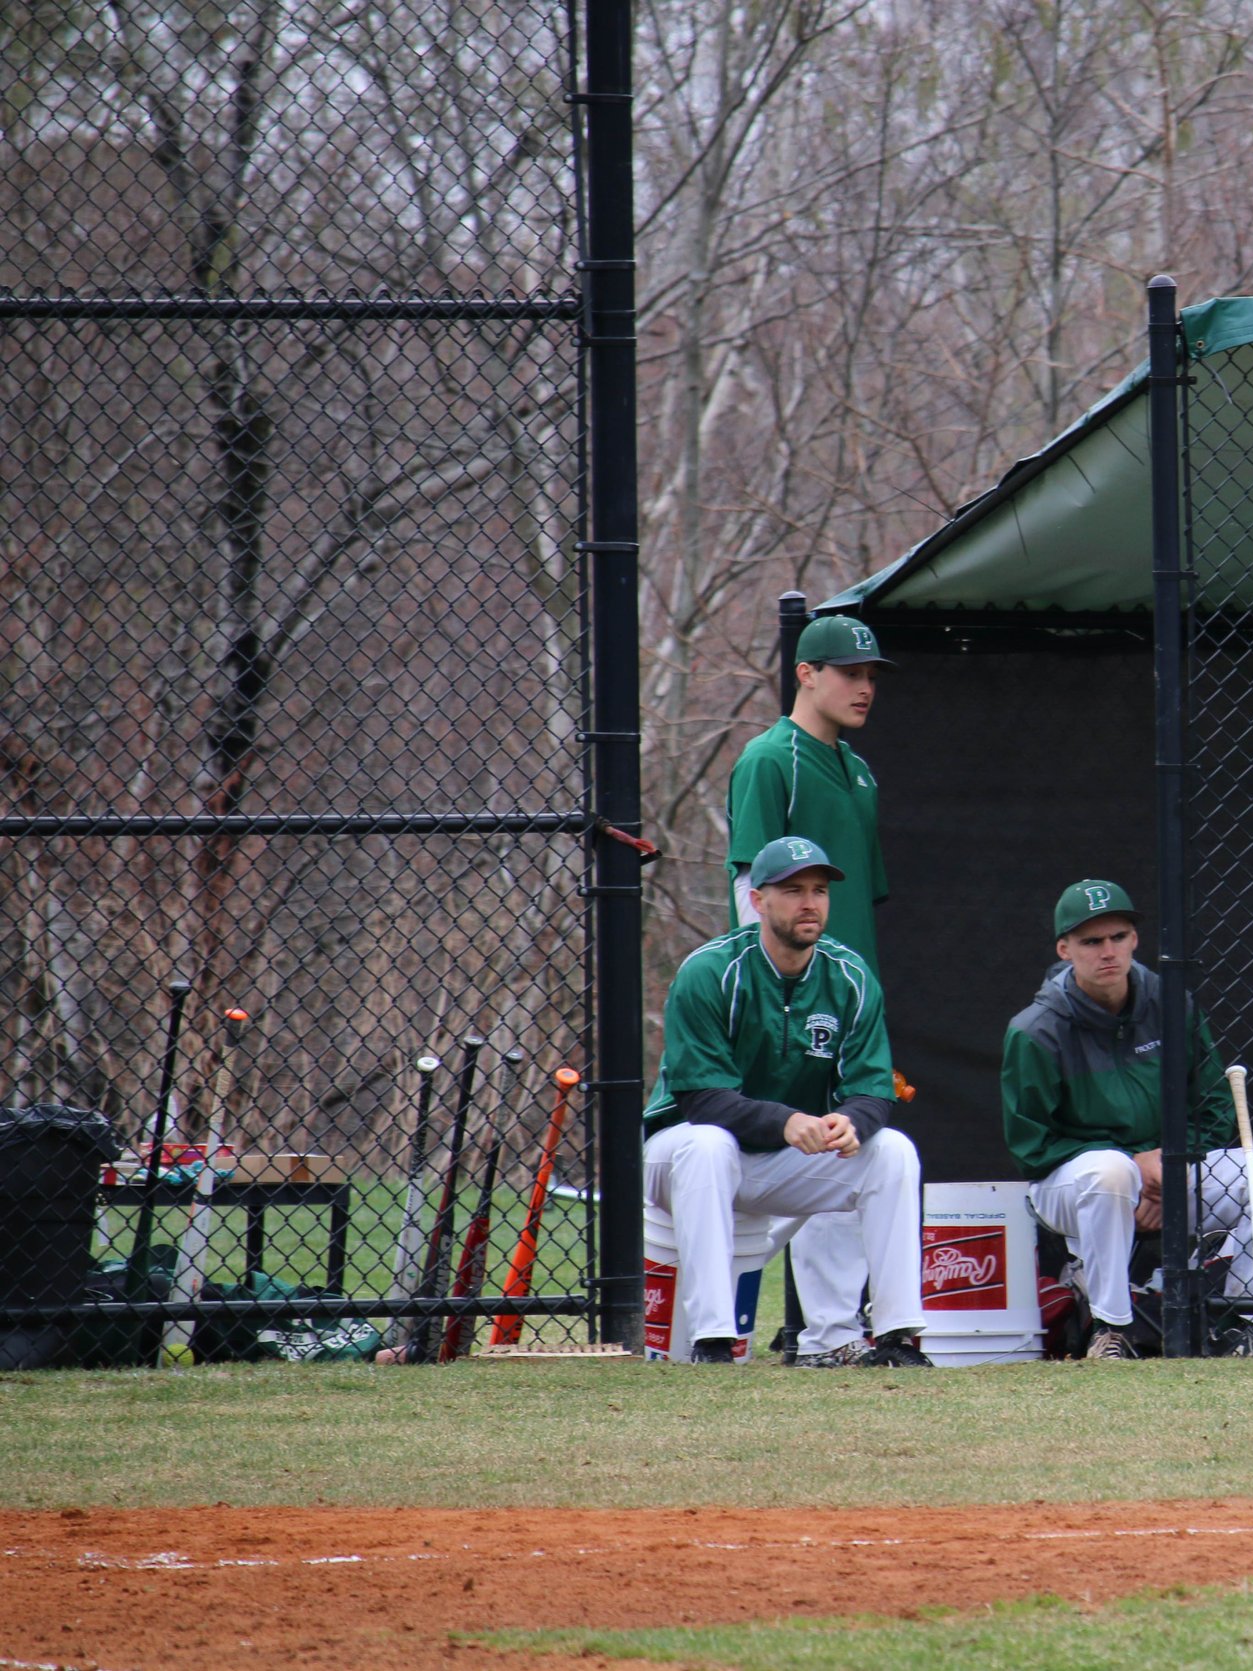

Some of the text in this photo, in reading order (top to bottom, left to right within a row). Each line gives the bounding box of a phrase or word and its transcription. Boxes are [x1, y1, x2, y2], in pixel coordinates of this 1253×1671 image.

[852, 627, 873, 650] P
[788, 840, 812, 861] P
[1085, 886, 1110, 911] P
[811, 1026, 832, 1051] P
